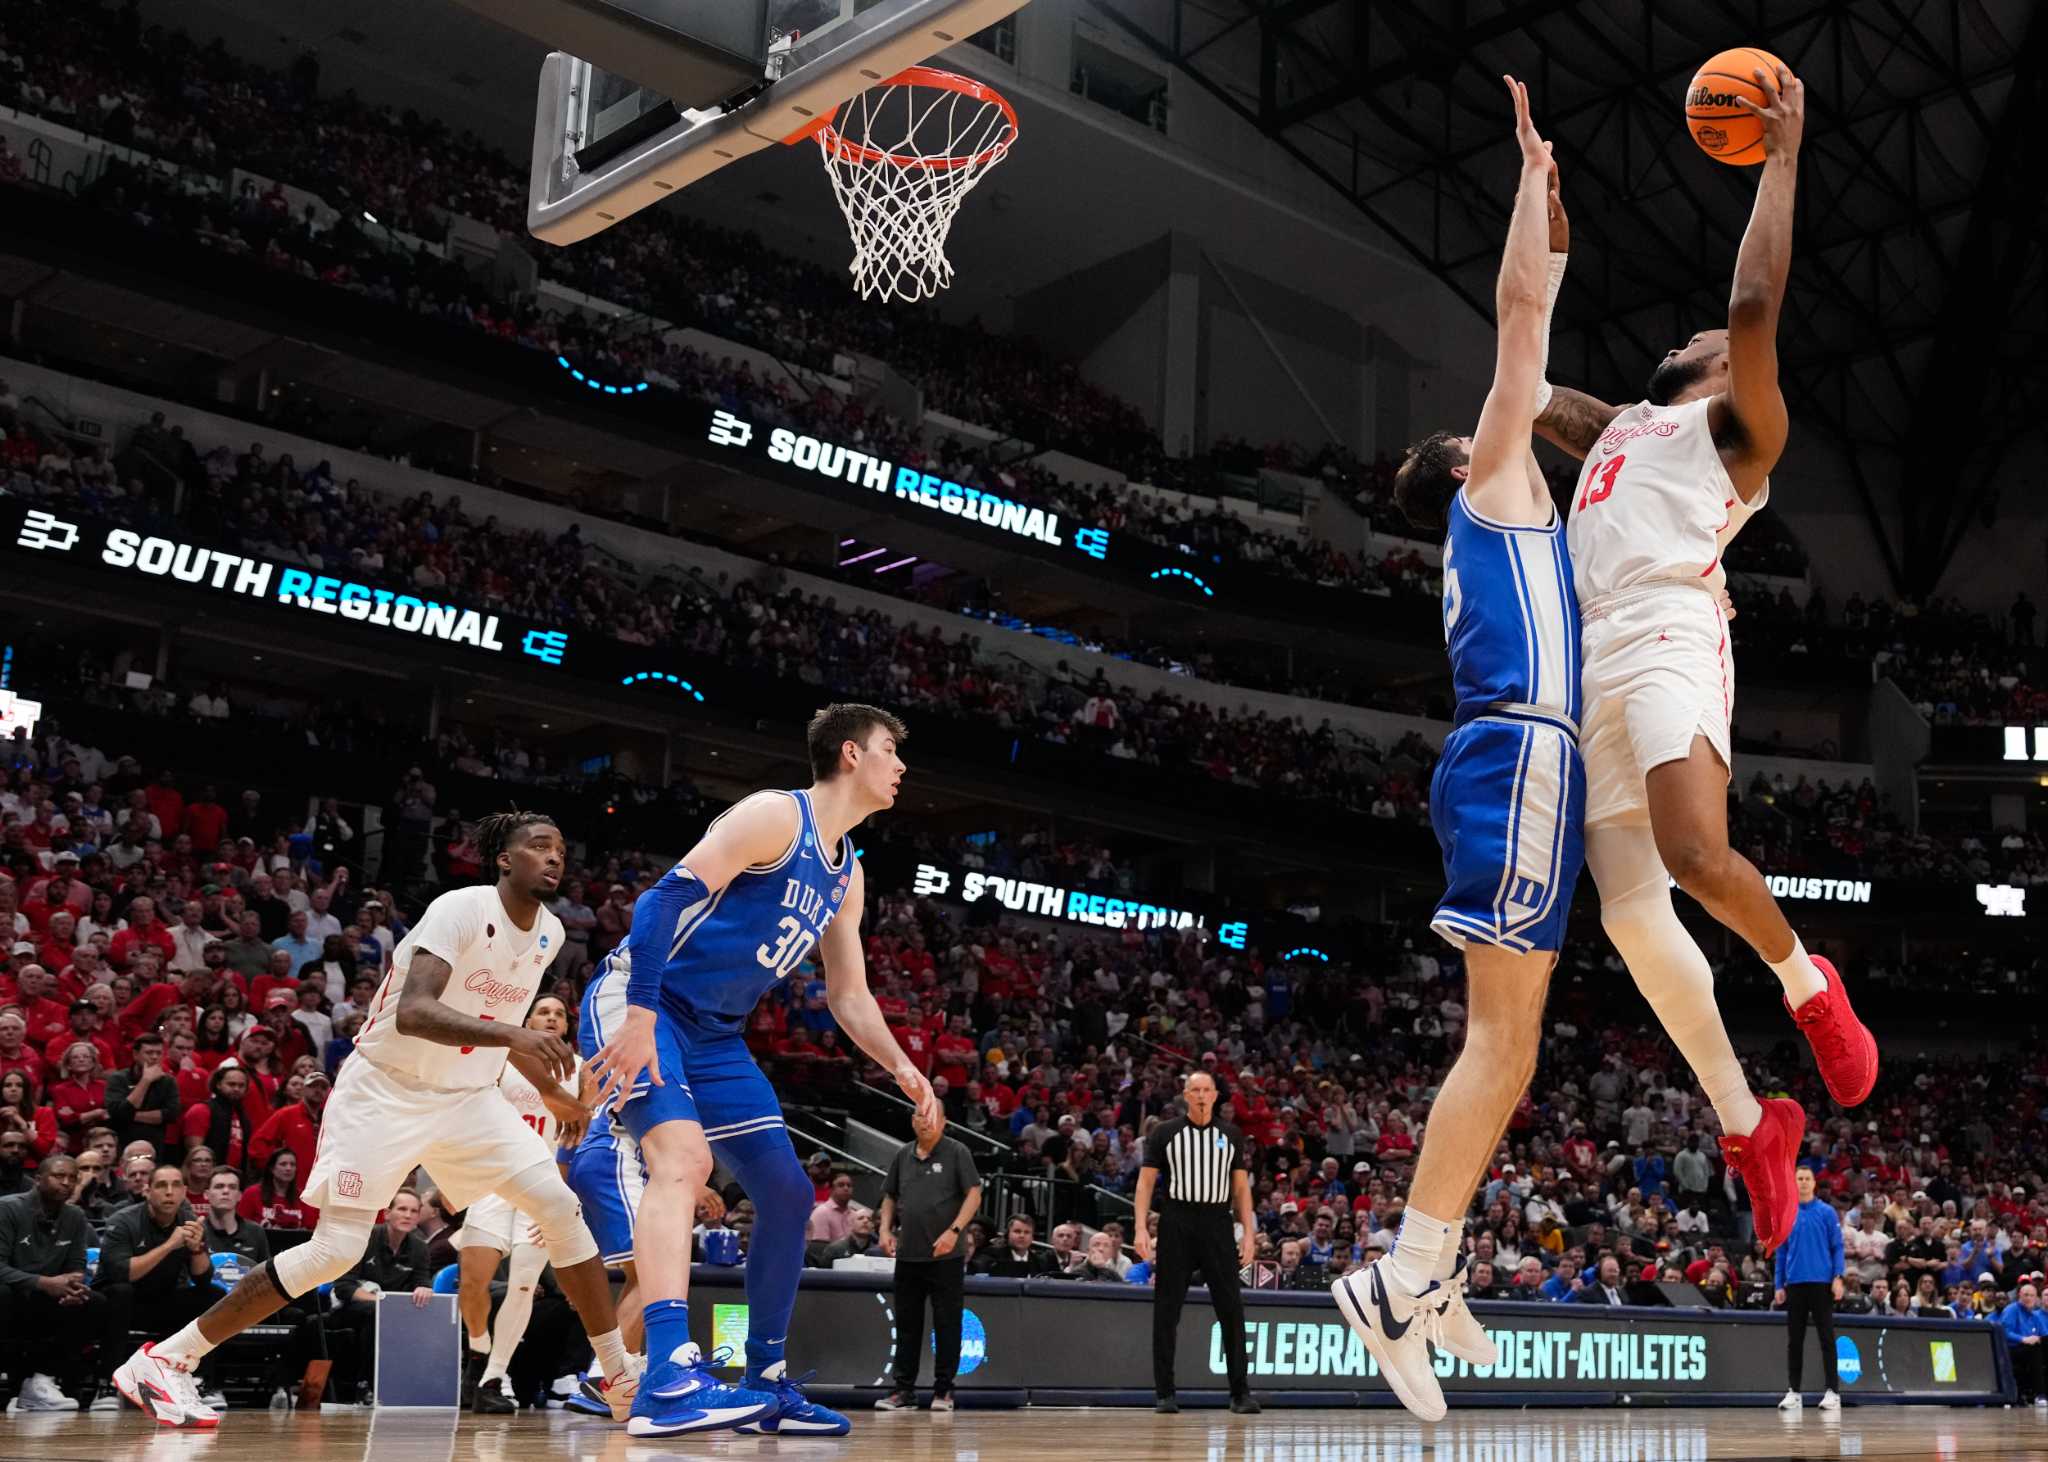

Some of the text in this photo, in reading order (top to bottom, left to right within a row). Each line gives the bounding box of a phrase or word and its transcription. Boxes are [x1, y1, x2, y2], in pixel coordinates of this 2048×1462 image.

[767, 428, 1062, 545] SOUTH REGIONAL
[1578, 454, 1626, 512] 13
[102, 528, 503, 651] SOUTH REGIONAL
[781, 878, 835, 936] DUKE
[756, 915, 815, 979] 30
